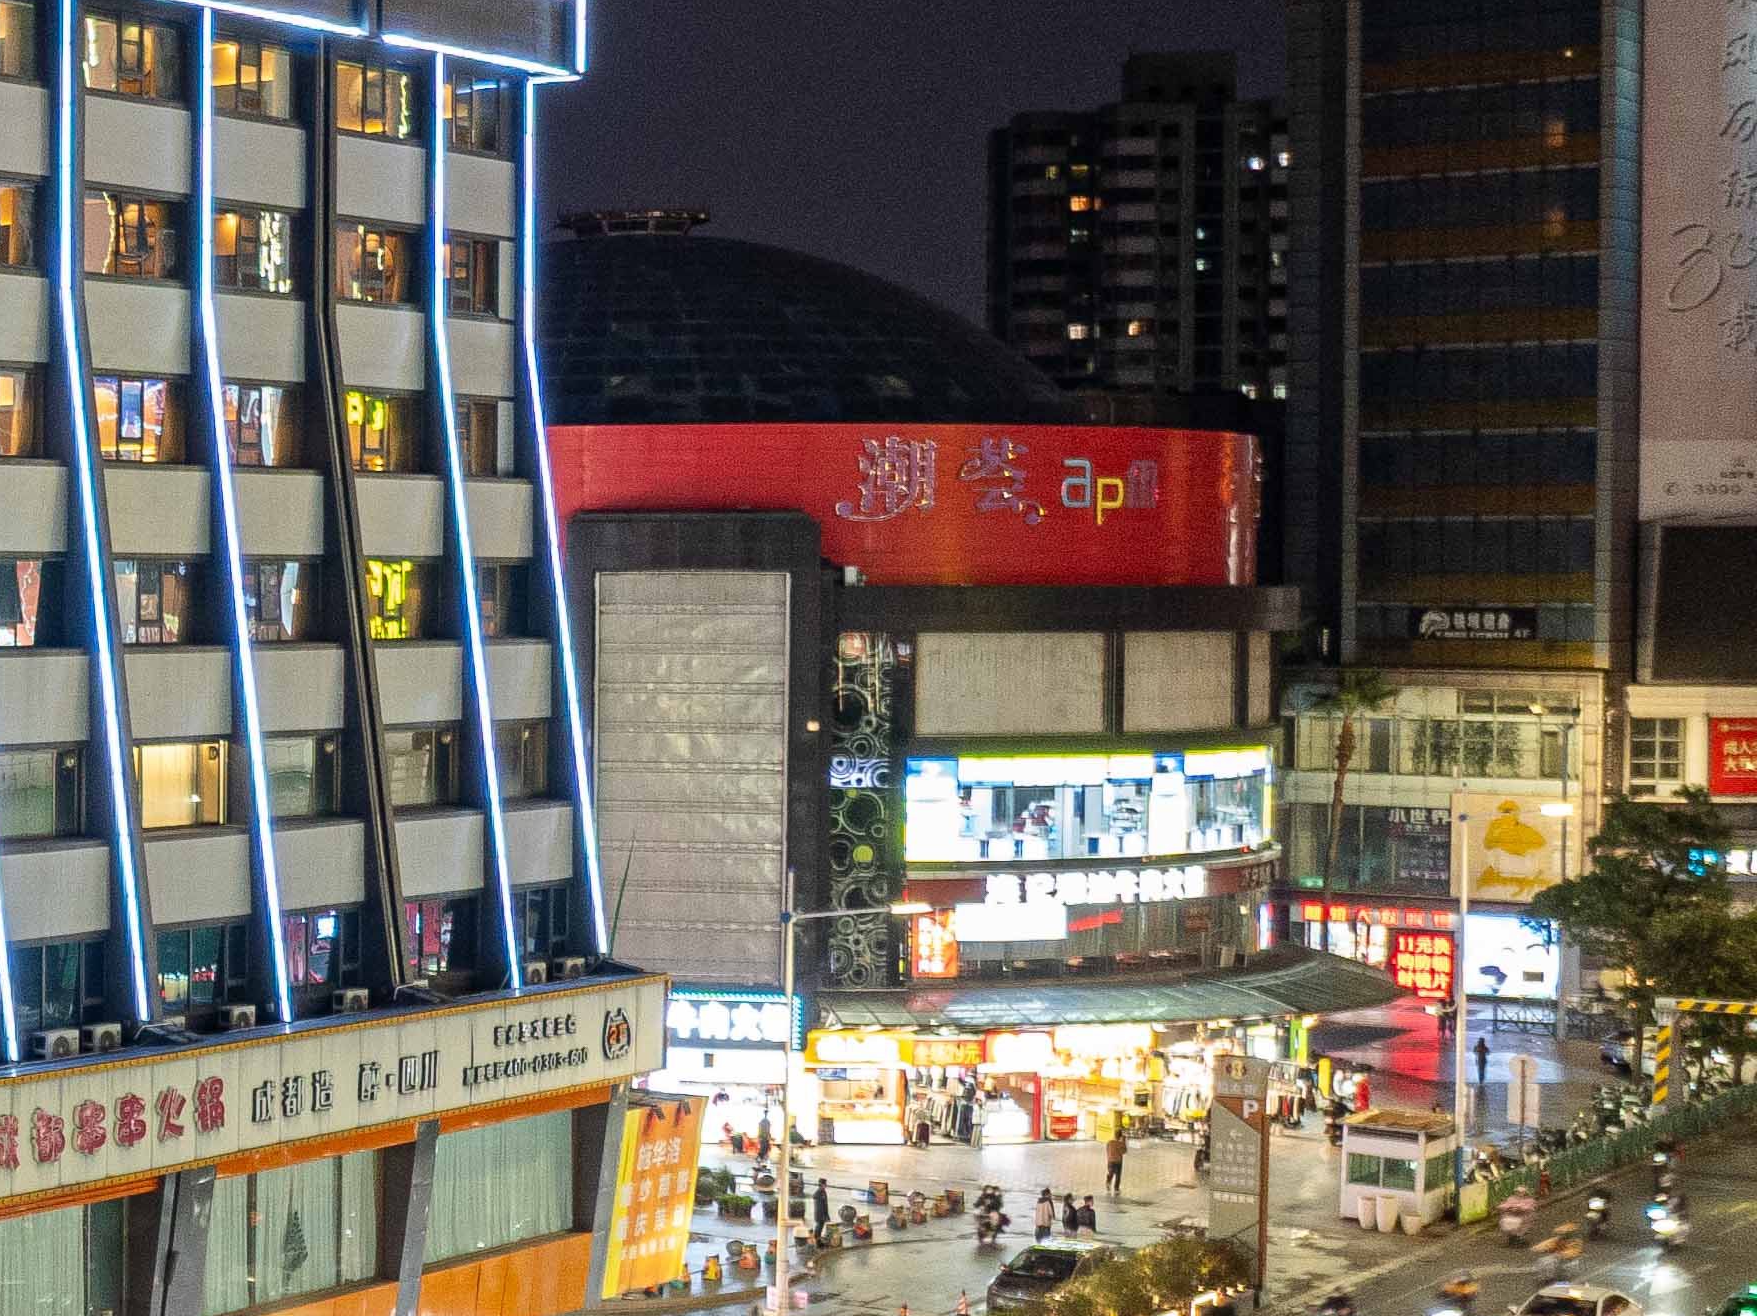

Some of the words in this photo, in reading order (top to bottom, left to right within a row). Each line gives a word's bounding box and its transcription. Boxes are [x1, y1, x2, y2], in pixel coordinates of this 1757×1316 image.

[252, 1069, 334, 1122] 成都造
[1242, 1099, 1260, 1119] P
